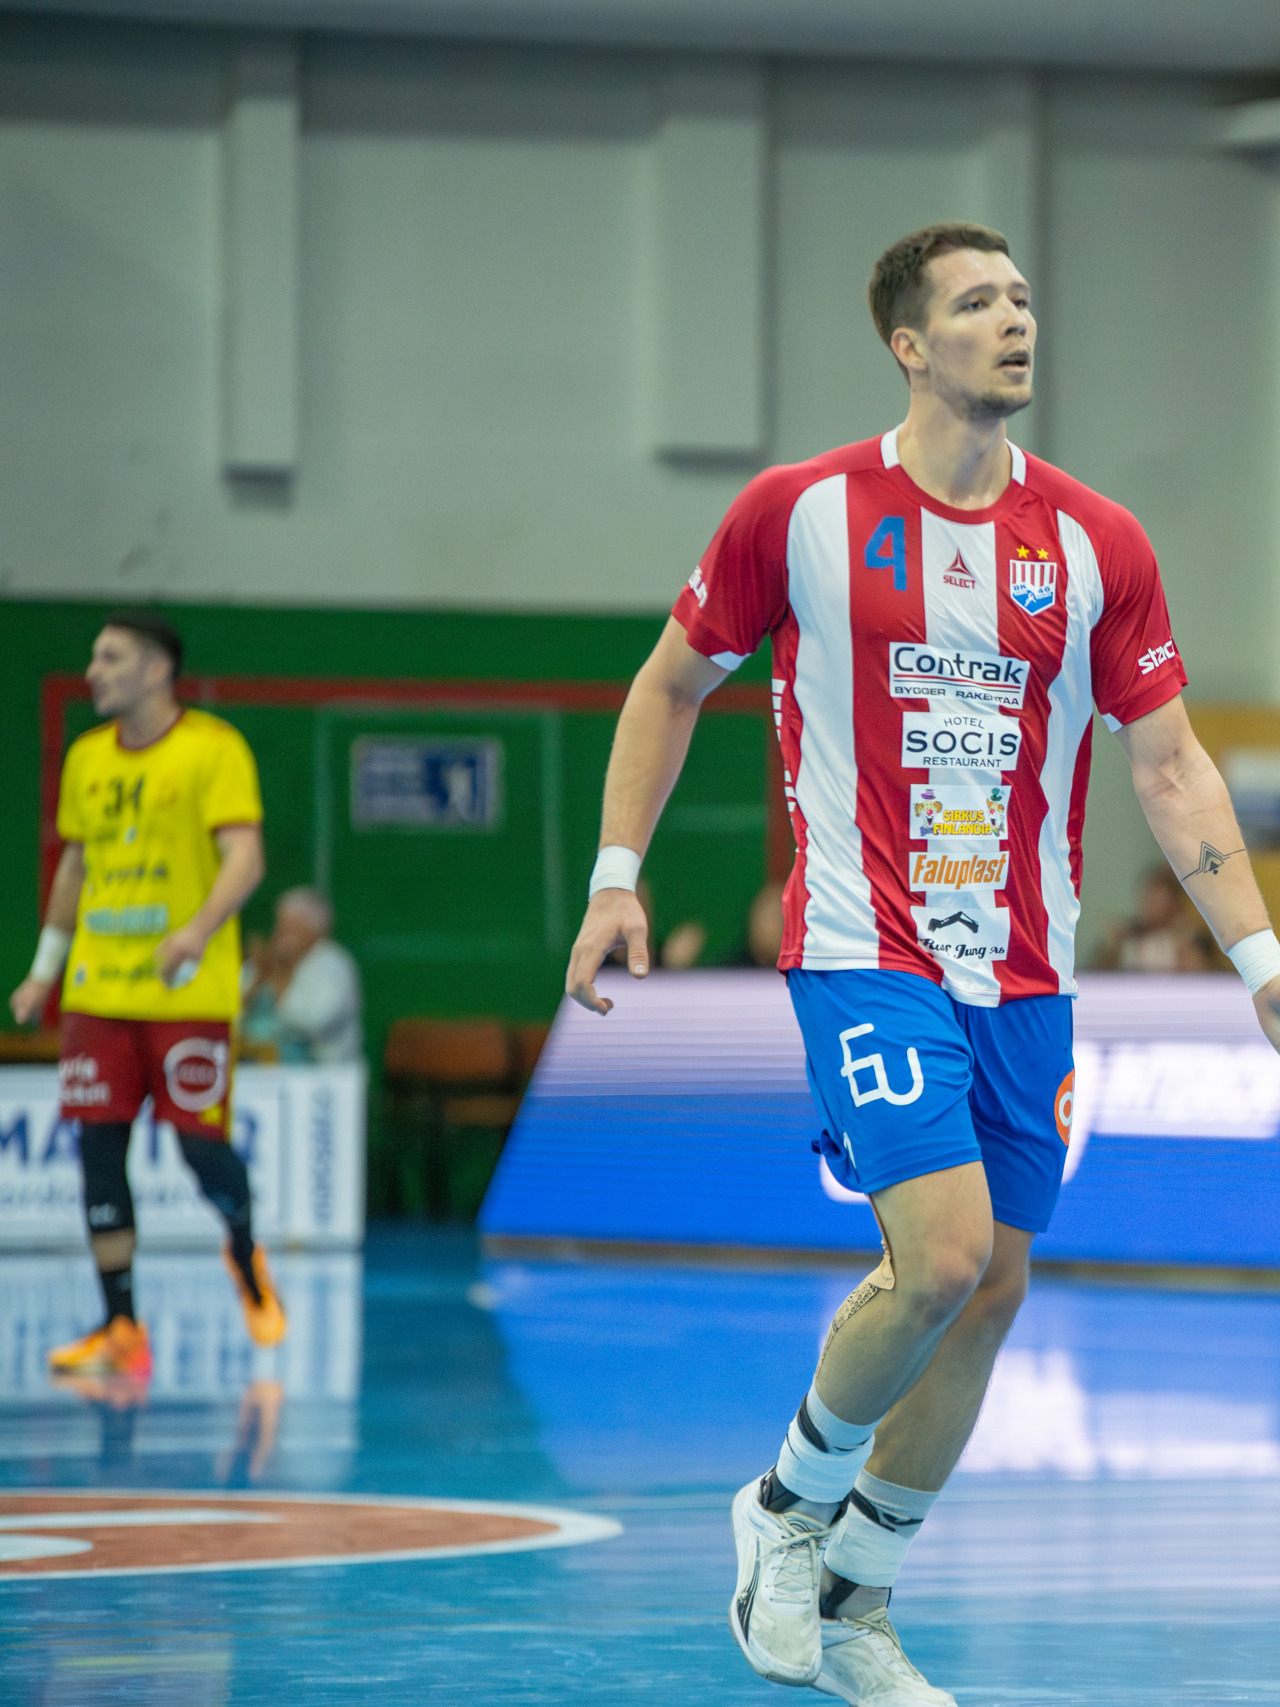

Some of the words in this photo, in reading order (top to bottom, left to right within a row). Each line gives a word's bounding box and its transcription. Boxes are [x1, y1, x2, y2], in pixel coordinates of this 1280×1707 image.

[864, 515, 907, 591] 4
[943, 574, 976, 589] SELECT
[894, 646, 1025, 685] Contrak
[894, 685, 946, 696] BYGGER
[943, 716, 985, 730] HOTEL
[905, 730, 1019, 756] SOCIS
[922, 756, 1003, 768] RESTAURANT
[942, 810, 986, 823] SIRKUS
[932, 822, 993, 836] FINLANDIA
[911, 854, 1007, 890] Faluplast
